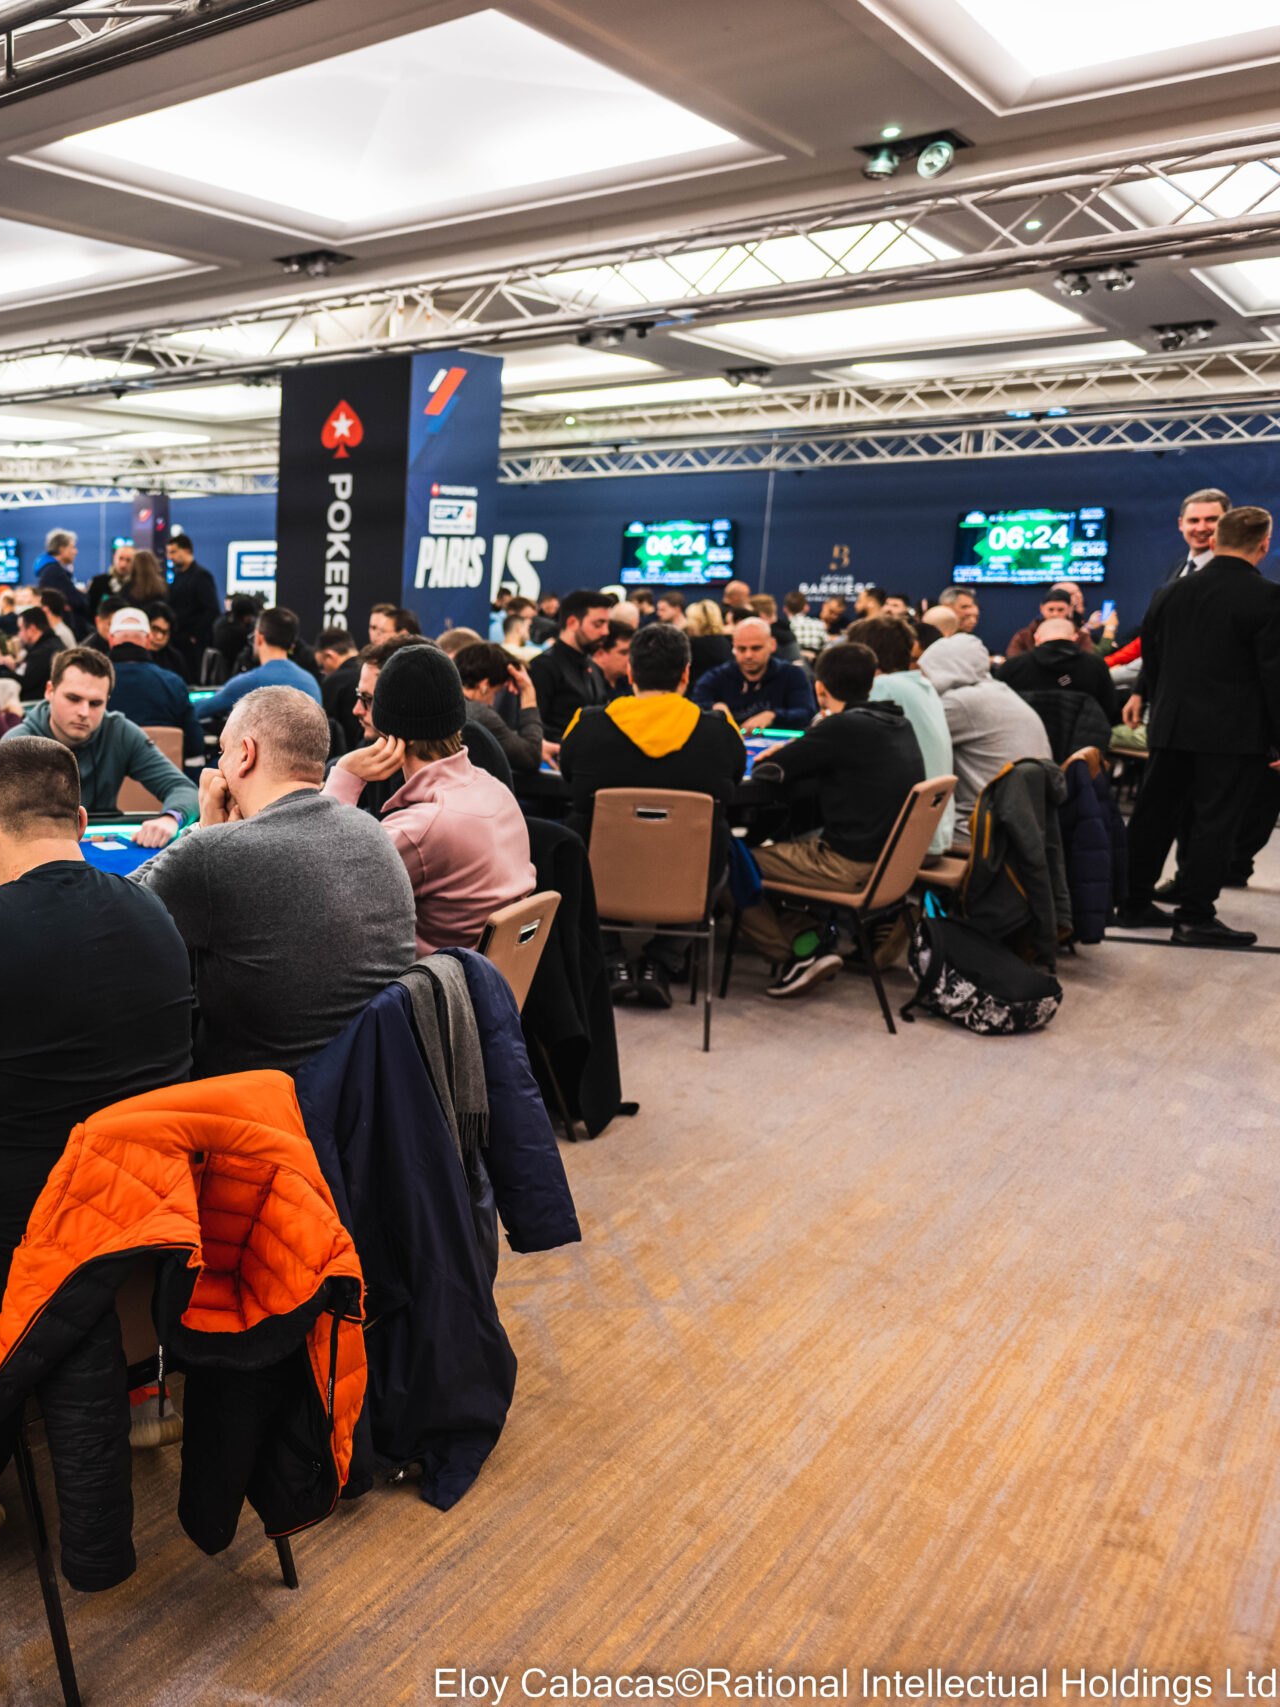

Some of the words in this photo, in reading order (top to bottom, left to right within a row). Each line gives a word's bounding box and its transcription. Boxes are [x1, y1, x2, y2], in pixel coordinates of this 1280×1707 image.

[645, 534, 707, 556] 06:24
[988, 524, 1070, 550] 06:24
[414, 536, 487, 589] PARIS
